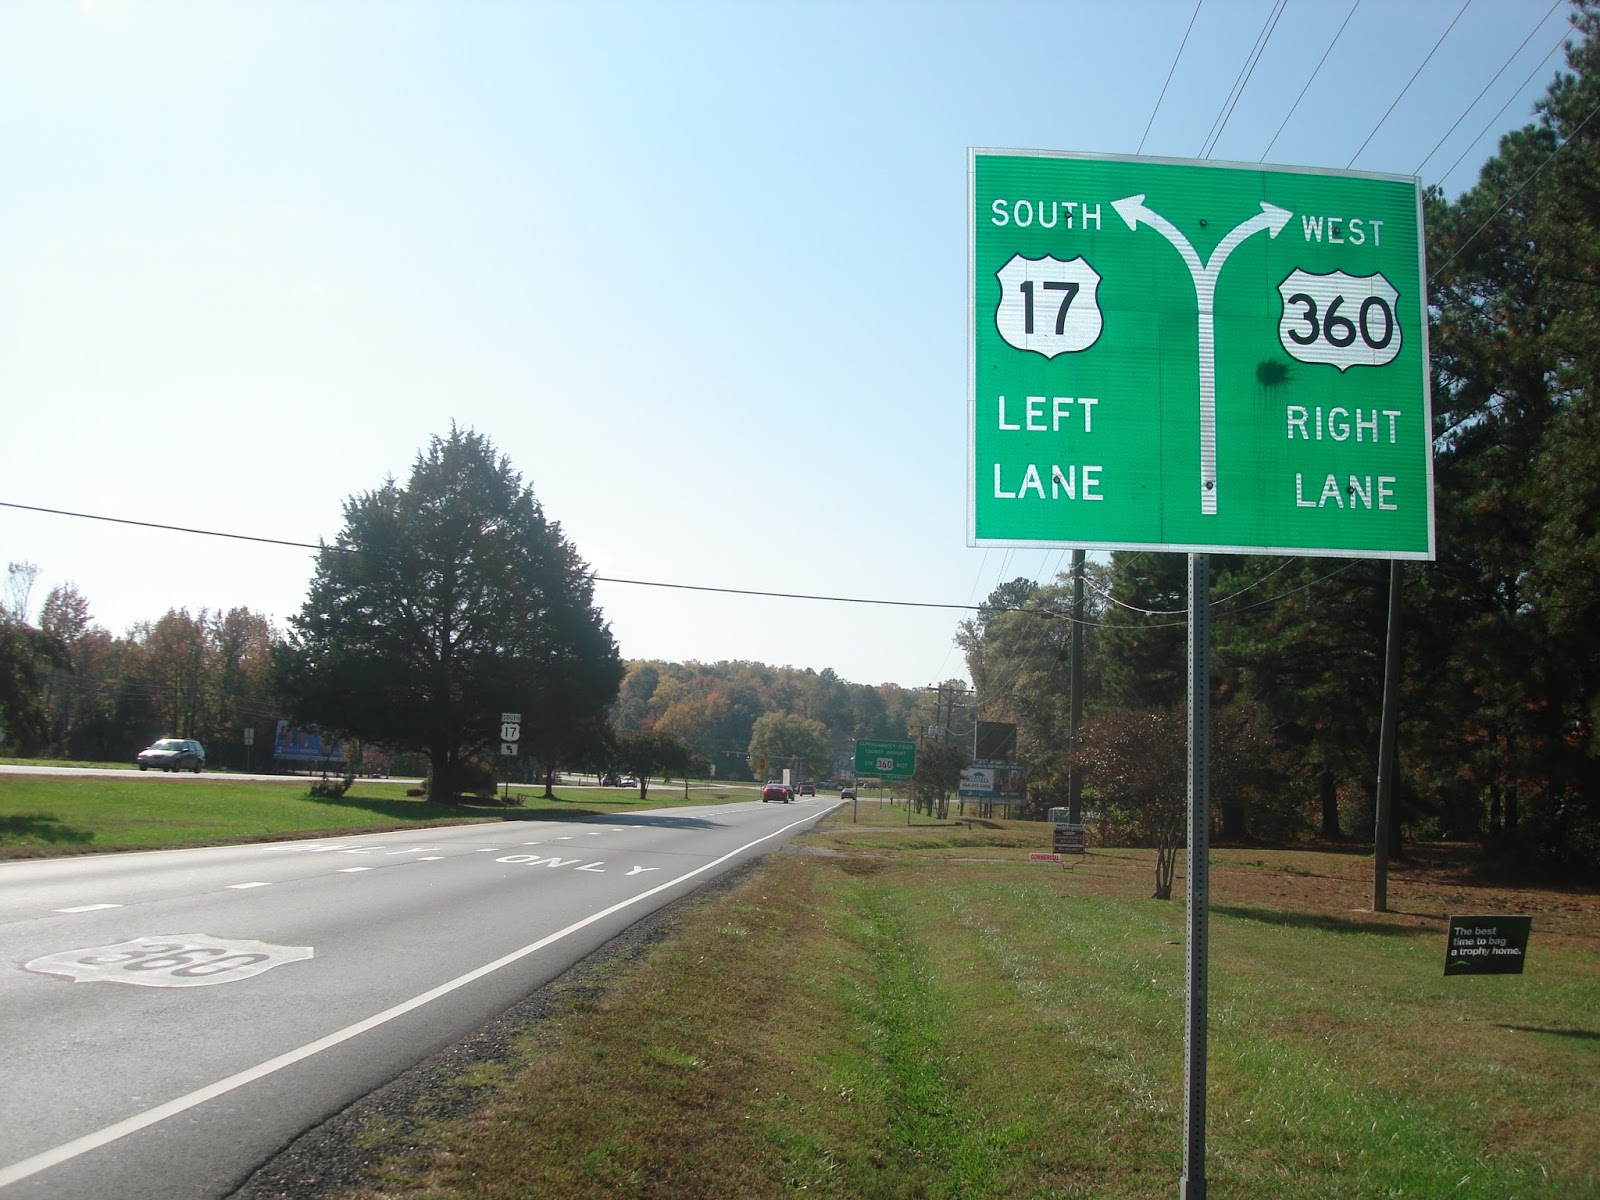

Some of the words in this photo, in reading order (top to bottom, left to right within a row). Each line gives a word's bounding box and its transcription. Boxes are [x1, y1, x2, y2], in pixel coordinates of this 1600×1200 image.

[991, 199, 1101, 230] SOUTH
[1302, 215, 1384, 247] WEST
[1020, 280, 1080, 335] 17
[1287, 293, 1394, 350] 360
[999, 395, 1099, 432] LEFT
[1287, 405, 1401, 444] RIGHT
[994, 463, 1104, 501] LANE
[1296, 472, 1398, 511] LANE
[505, 726, 517, 737] 17
[877, 760, 893, 769] 360
[495, 854, 661, 876] ONLY
[1453, 937, 1474, 946] time
[1476, 937, 1487, 945] to
[1488, 937, 1507, 946] bag
[1454, 927, 1472, 935] The
[1475, 927, 1497, 935] best
[76, 943, 270, 977] 360
[1460, 947, 1490, 956] trophy
[1492, 947, 1522, 955] home.
